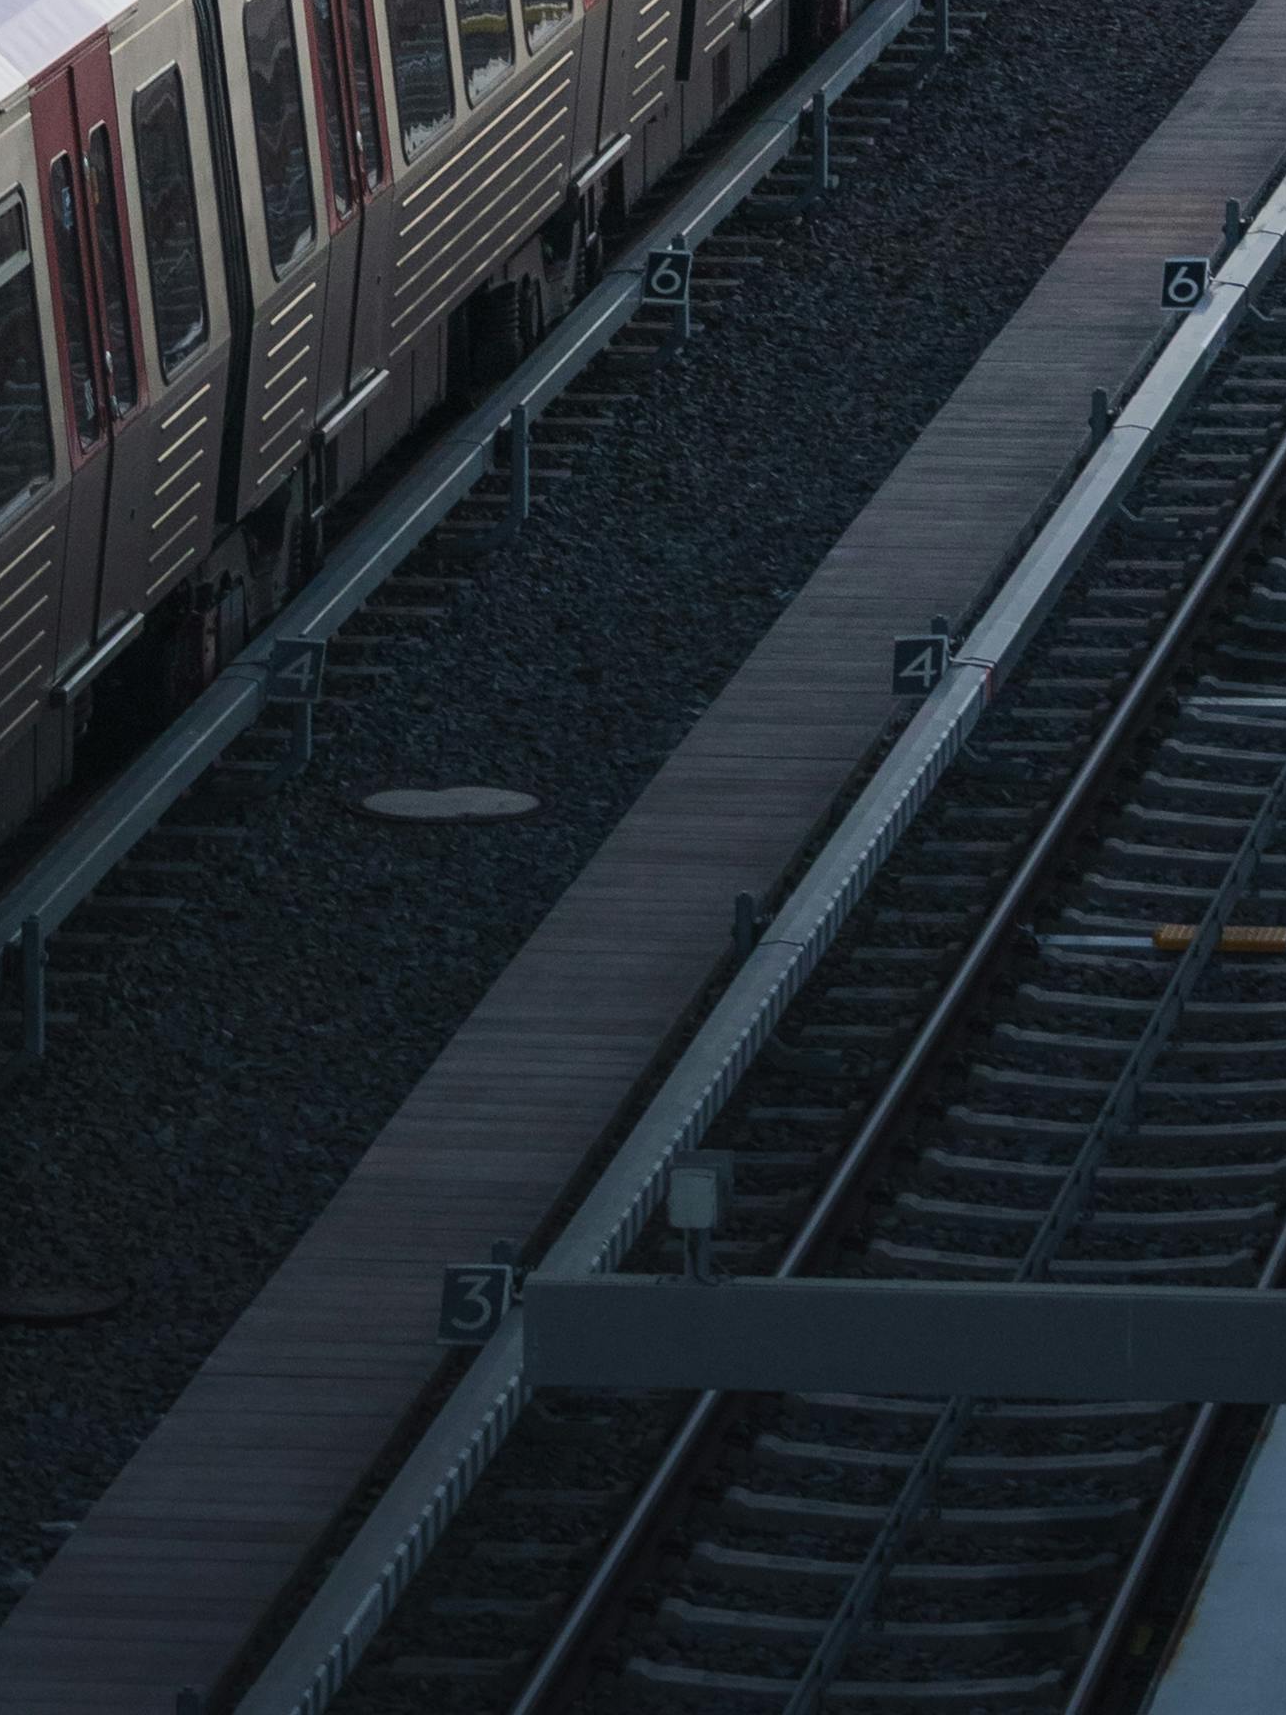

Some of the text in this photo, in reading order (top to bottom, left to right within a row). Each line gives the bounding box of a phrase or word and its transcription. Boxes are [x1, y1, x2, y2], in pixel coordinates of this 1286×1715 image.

[651, 257, 682, 295] 6
[1168, 265, 1199, 303] 6
[275, 651, 314, 691] 4
[898, 646, 937, 688] 4
[451, 1274, 493, 1331] 3
